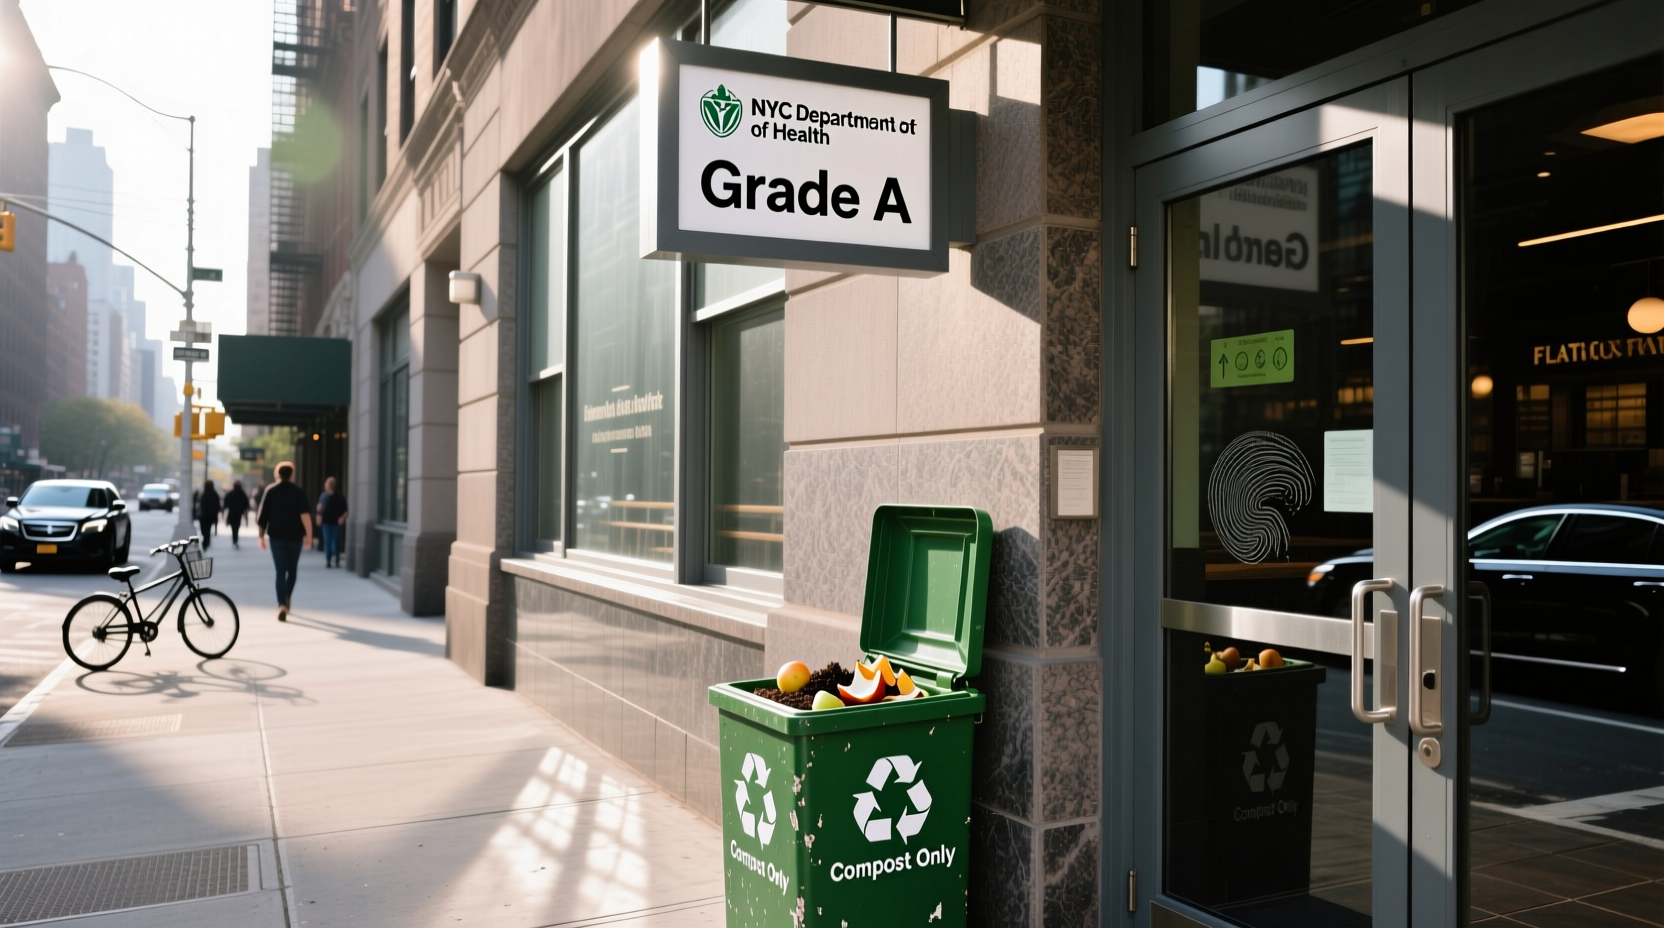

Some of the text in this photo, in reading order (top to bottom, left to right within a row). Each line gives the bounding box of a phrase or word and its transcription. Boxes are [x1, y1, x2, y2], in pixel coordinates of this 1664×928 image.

[751, 98, 793, 120] NYC
[751, 121, 830, 145] of Health
[700, 159, 912, 224] Grade A
[830, 844, 956, 882] Compost Only
